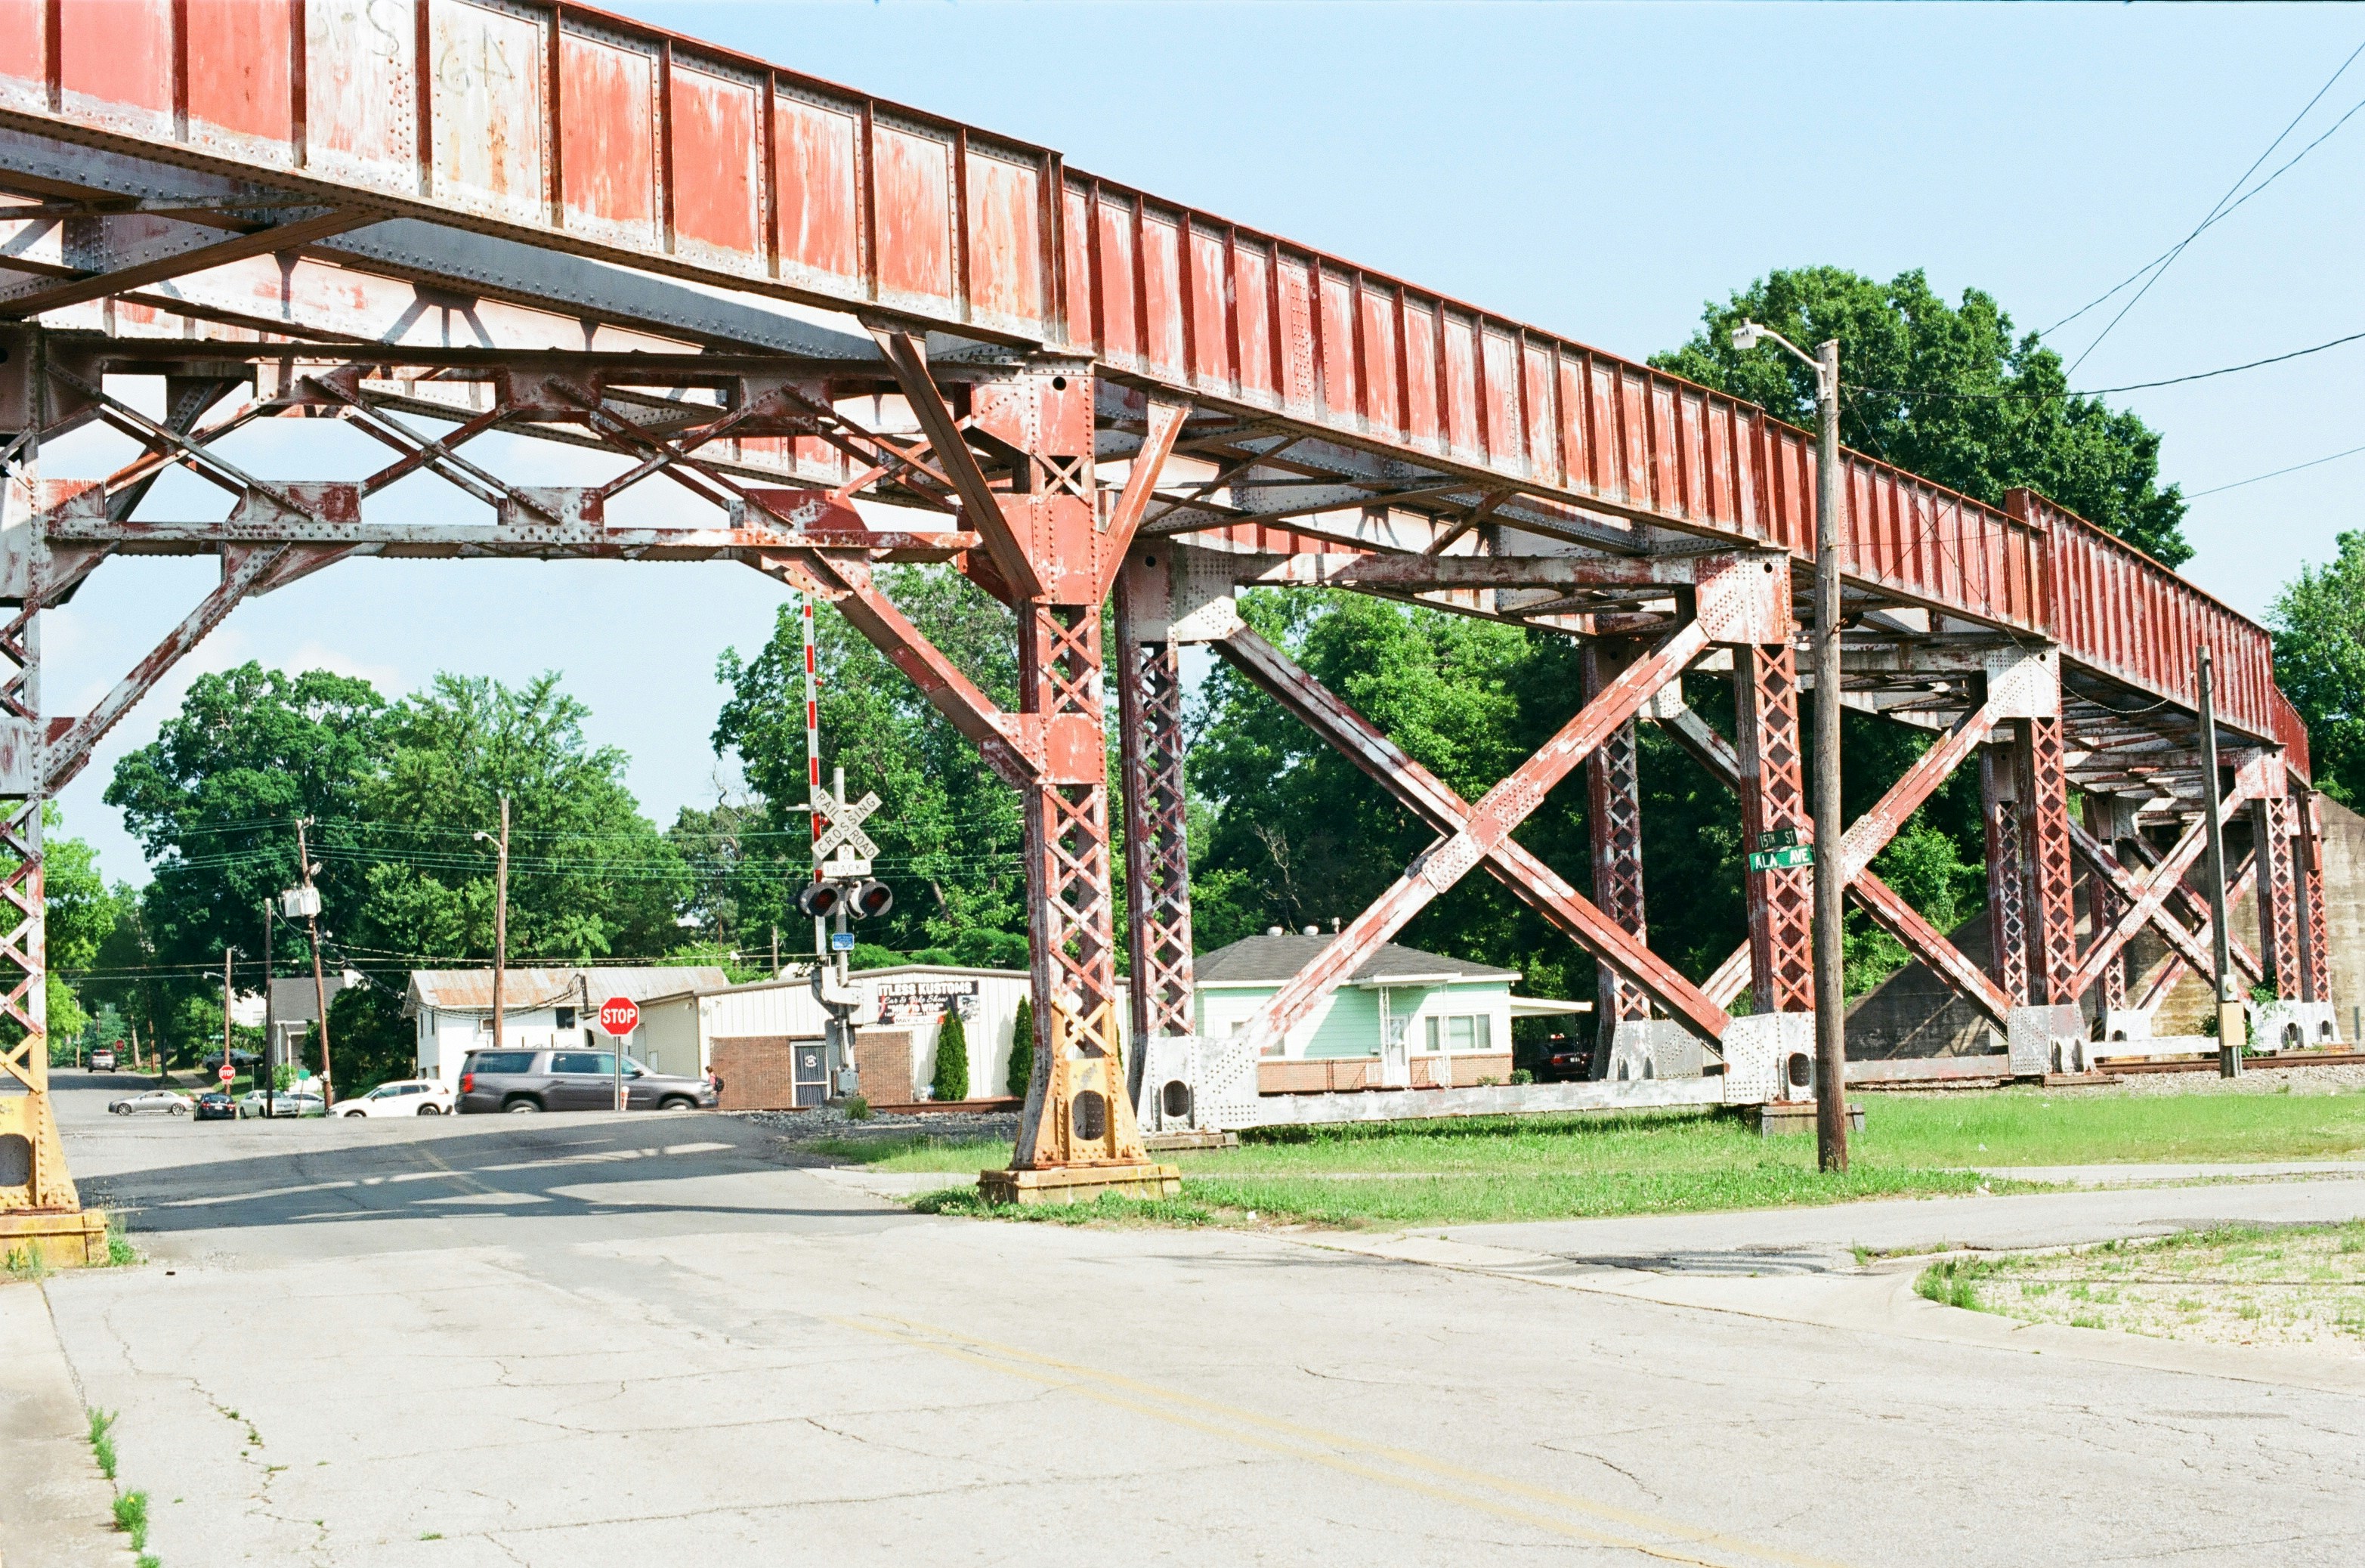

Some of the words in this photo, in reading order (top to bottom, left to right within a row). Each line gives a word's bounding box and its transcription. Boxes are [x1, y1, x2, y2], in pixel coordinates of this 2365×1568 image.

[816, 793, 839, 820] RAIL
[849, 829, 875, 858] ROAD
[818, 797, 876, 853] CROSSING
[1759, 833, 1776, 848] 15TH
[1785, 830, 1795, 844] ST
[1755, 853, 1778, 869] ALA
[1789, 847, 1810, 864] AVE
[918, 982, 972, 994] KUSTOMS
[926, 994, 948, 1003] Show
[602, 1008, 636, 1024] STOP
